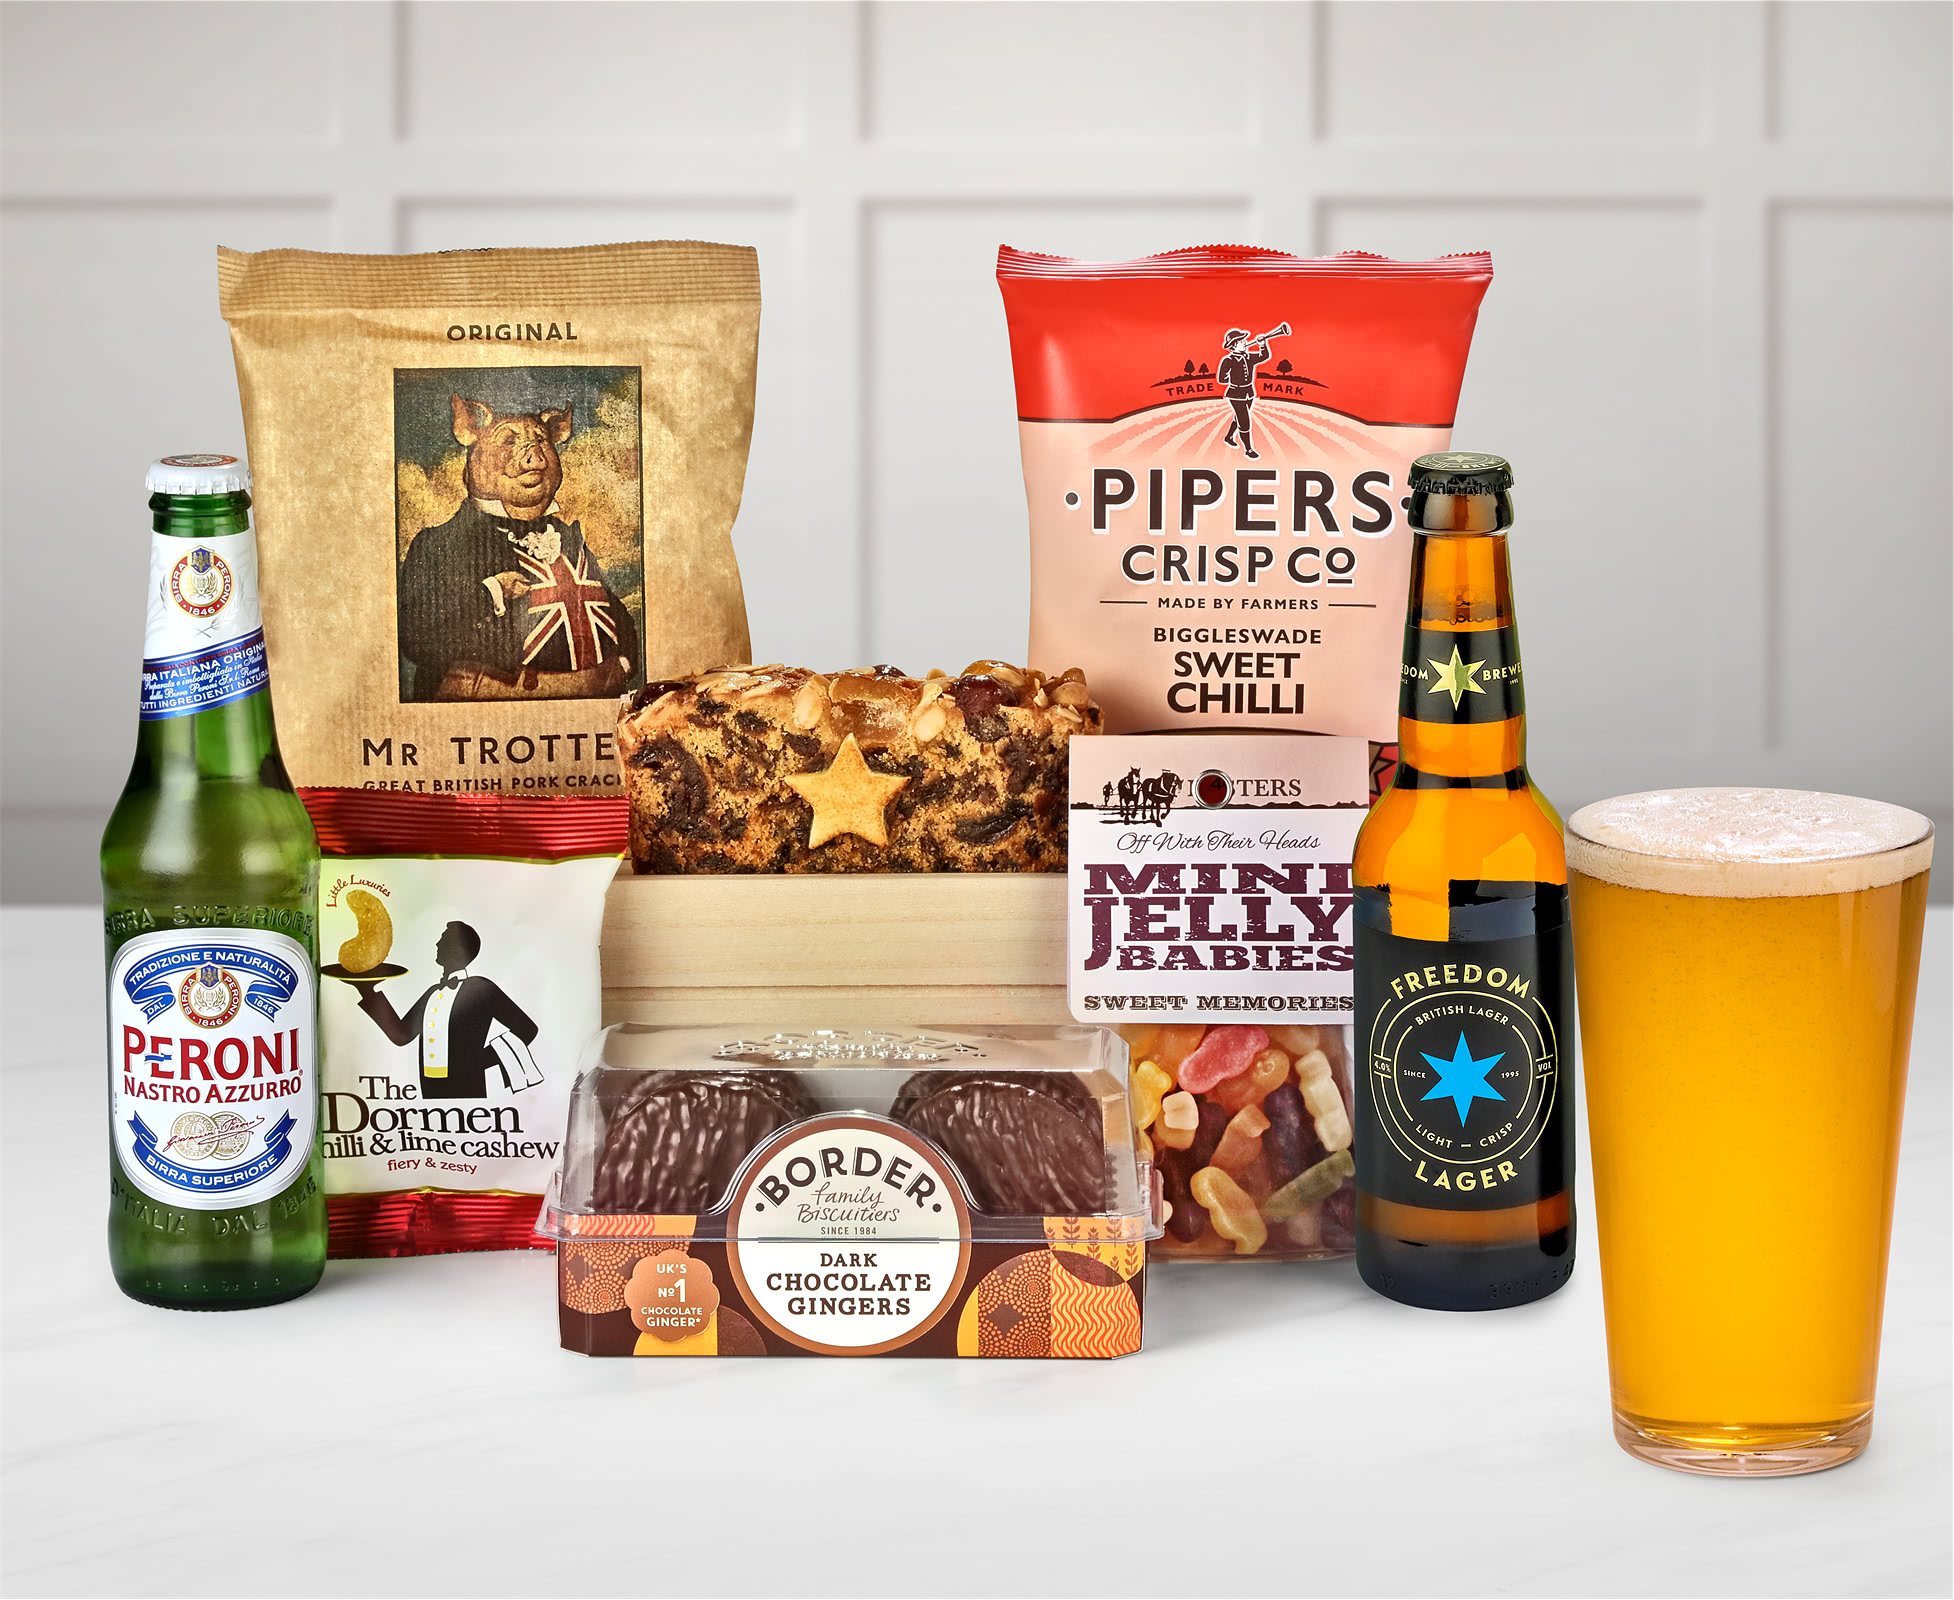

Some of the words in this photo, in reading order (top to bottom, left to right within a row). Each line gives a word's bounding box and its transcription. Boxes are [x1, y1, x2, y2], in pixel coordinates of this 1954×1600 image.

[446, 322, 578, 342] ORIGINAL
[1166, 383, 1215, 398] TRADE
[1263, 382, 1304, 396] MARK
[1092, 468, 1393, 533] PIPERS
[1121, 544, 1275, 585] CRISP
[172, 562, 187, 603] BIRRA
[215, 560, 232, 605] PERONI
[188, 606, 216, 616] 1846
[1158, 597, 1206, 609] MADE
[1213, 598, 1234, 610] BY
[1241, 599, 1319, 610] FARMERS
[1153, 627, 1322, 644] BIGGLESWADE
[159, 658, 221, 681] ITALIANA
[1173, 651, 1301, 678] SWEET
[158, 685, 235, 709] INGREDIENTI
[1166, 682, 1305, 714] CHILLI
[363, 779, 425, 793] GREAT
[433, 778, 501, 793] BRITISH
[511, 776, 559, 790] PORK
[1116, 830, 1152, 854] Off
[1152, 831, 1204, 851] With
[1207, 830, 1256, 851] Their
[1258, 830, 1321, 851] Heads
[326, 878, 348, 907] Little
[350, 874, 391, 897] Luxuries
[1083, 863, 1353, 895] MINI
[173, 905, 313, 936] SUPERIORE
[1083, 896, 1353, 971] JELLY
[129, 951, 200, 985] TRADIZIONE
[203, 951, 213, 961] E
[1116, 945, 1353, 971] BABIES
[1390, 964, 1531, 1000] FREEDOM
[147, 1001, 166, 1016] DAL
[182, 978, 196, 1015] BIRRA
[225, 977, 239, 1016] PERONI
[253, 998, 275, 1014] 1846
[1084, 995, 1188, 1011] SWEET
[1196, 995, 1353, 1011] MEMORIES
[197, 1017, 223, 1027] 1846
[1415, 1005, 1465, 1026] BRITISH
[1468, 1005, 1510, 1026] LAGER
[123, 1024, 299, 1081] PERONI
[1374, 1061, 1392, 1073] 4.0%
[1403, 1069, 1427, 1079] SINCE
[1501, 1070, 1520, 1079] 1995
[124, 1075, 200, 1104] NASTRO
[204, 1076, 301, 1104] AZZURRO
[359, 1075, 417, 1100] The
[322, 1092, 524, 1134] Dormen
[370, 1133, 396, 1156] &
[398, 1130, 457, 1155] lime
[461, 1131, 560, 1160] cashew
[1415, 1123, 1454, 1149] LIGHT
[1479, 1122, 1514, 1147] CRISP
[146, 1154, 188, 1184] BIRRA
[191, 1153, 278, 1186] SUPERIORE
[387, 1158, 421, 1172] fiery
[425, 1157, 437, 1169] &
[440, 1161, 478, 1175] zesty
[756, 1146, 936, 1209] BORDER
[1415, 1160, 1518, 1191] LAGER
[811, 1181, 884, 1209] family
[211, 1211, 267, 1236] DAL
[797, 1203, 900, 1224] Biscuitiers
[821, 1226, 849, 1235] SINCE
[854, 1226, 877, 1235] 1984
[820, 1253, 878, 1267] DARK
[766, 1273, 931, 1292] CHOCOLATE
[641, 1307, 703, 1315] CHOCOLATE
[787, 1297, 911, 1316] GINGERS
